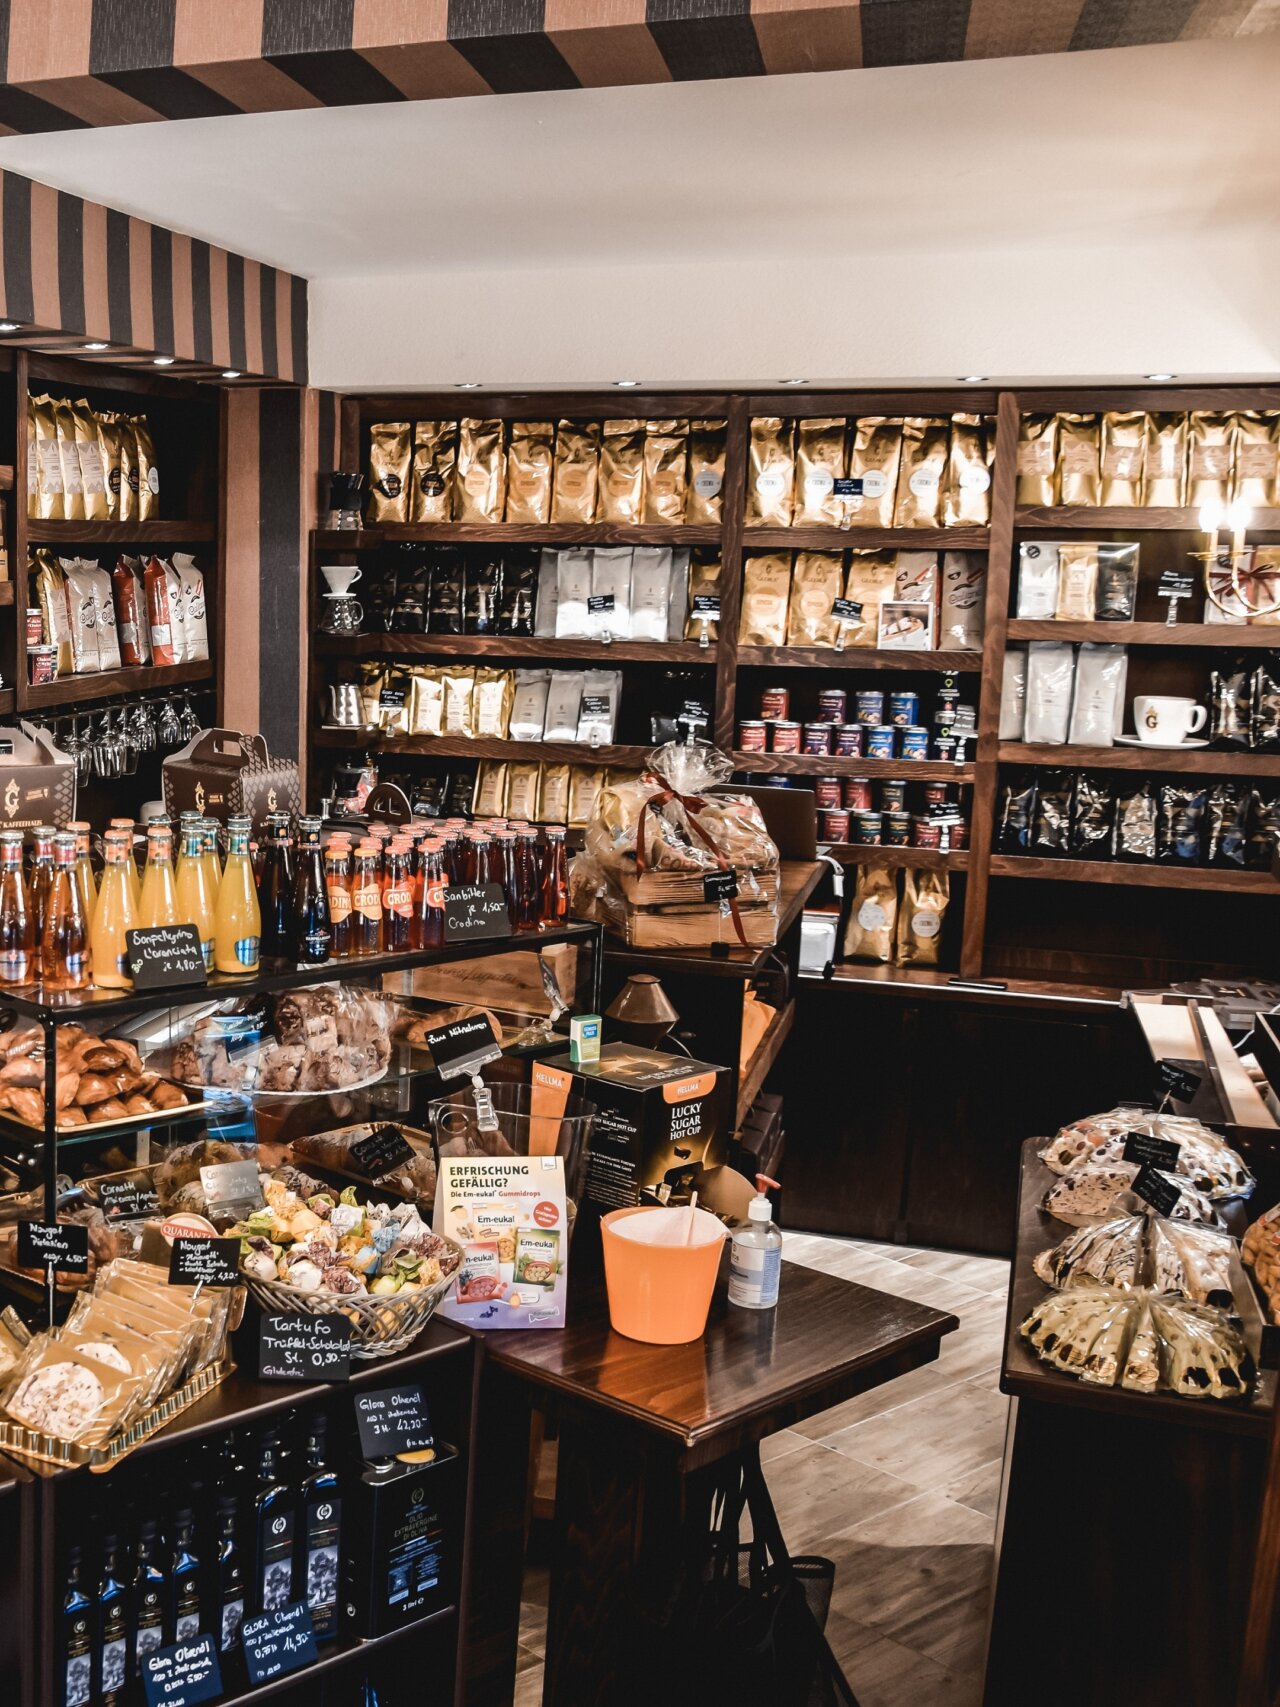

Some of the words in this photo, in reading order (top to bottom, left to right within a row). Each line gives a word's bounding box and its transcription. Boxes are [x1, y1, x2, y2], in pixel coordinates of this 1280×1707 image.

[1146, 715, 1158, 729] G
[3, 819, 43, 828] KAFFEEHAUS
[443, 889, 486, 903] Sanbitter
[468, 904, 476, 916] je
[133, 930, 193, 947] Sanpellegrino
[163, 961, 172, 972] je
[428, 1035, 446, 1044] Zum
[449, 1022, 487, 1037] Mitnehmen
[671, 1102, 703, 1120] LUCKY
[671, 1115, 701, 1133] SUGAR
[670, 1129, 686, 1141] HOT
[687, 1125, 702, 1137] CUP
[450, 1166, 529, 1176] ERFRISCHUNG
[451, 1176, 508, 1188] GEFÄLLIG?
[498, 1190, 541, 1198] Gummidrops
[477, 1215, 515, 1223] Em-eukal
[29, 1223, 63, 1240] Nougat
[180, 1240, 211, 1256] Nougat
[520, 1239, 555, 1248] Em-eukal
[269, 1317, 331, 1335] Tartufo
[284, 1351, 303, 1364] St.
[360, 1398, 386, 1410] Glora
[374, 1425, 380, 1434] 3
[408, 1512, 424, 1523] OLIO
[394, 1514, 438, 1538] EXTRAVERGINE
[403, 1533, 410, 1541] DI
[410, 1525, 428, 1538] OLIVA
[243, 1618, 269, 1636] GLORA
[149, 1657, 173, 1671] Glora
